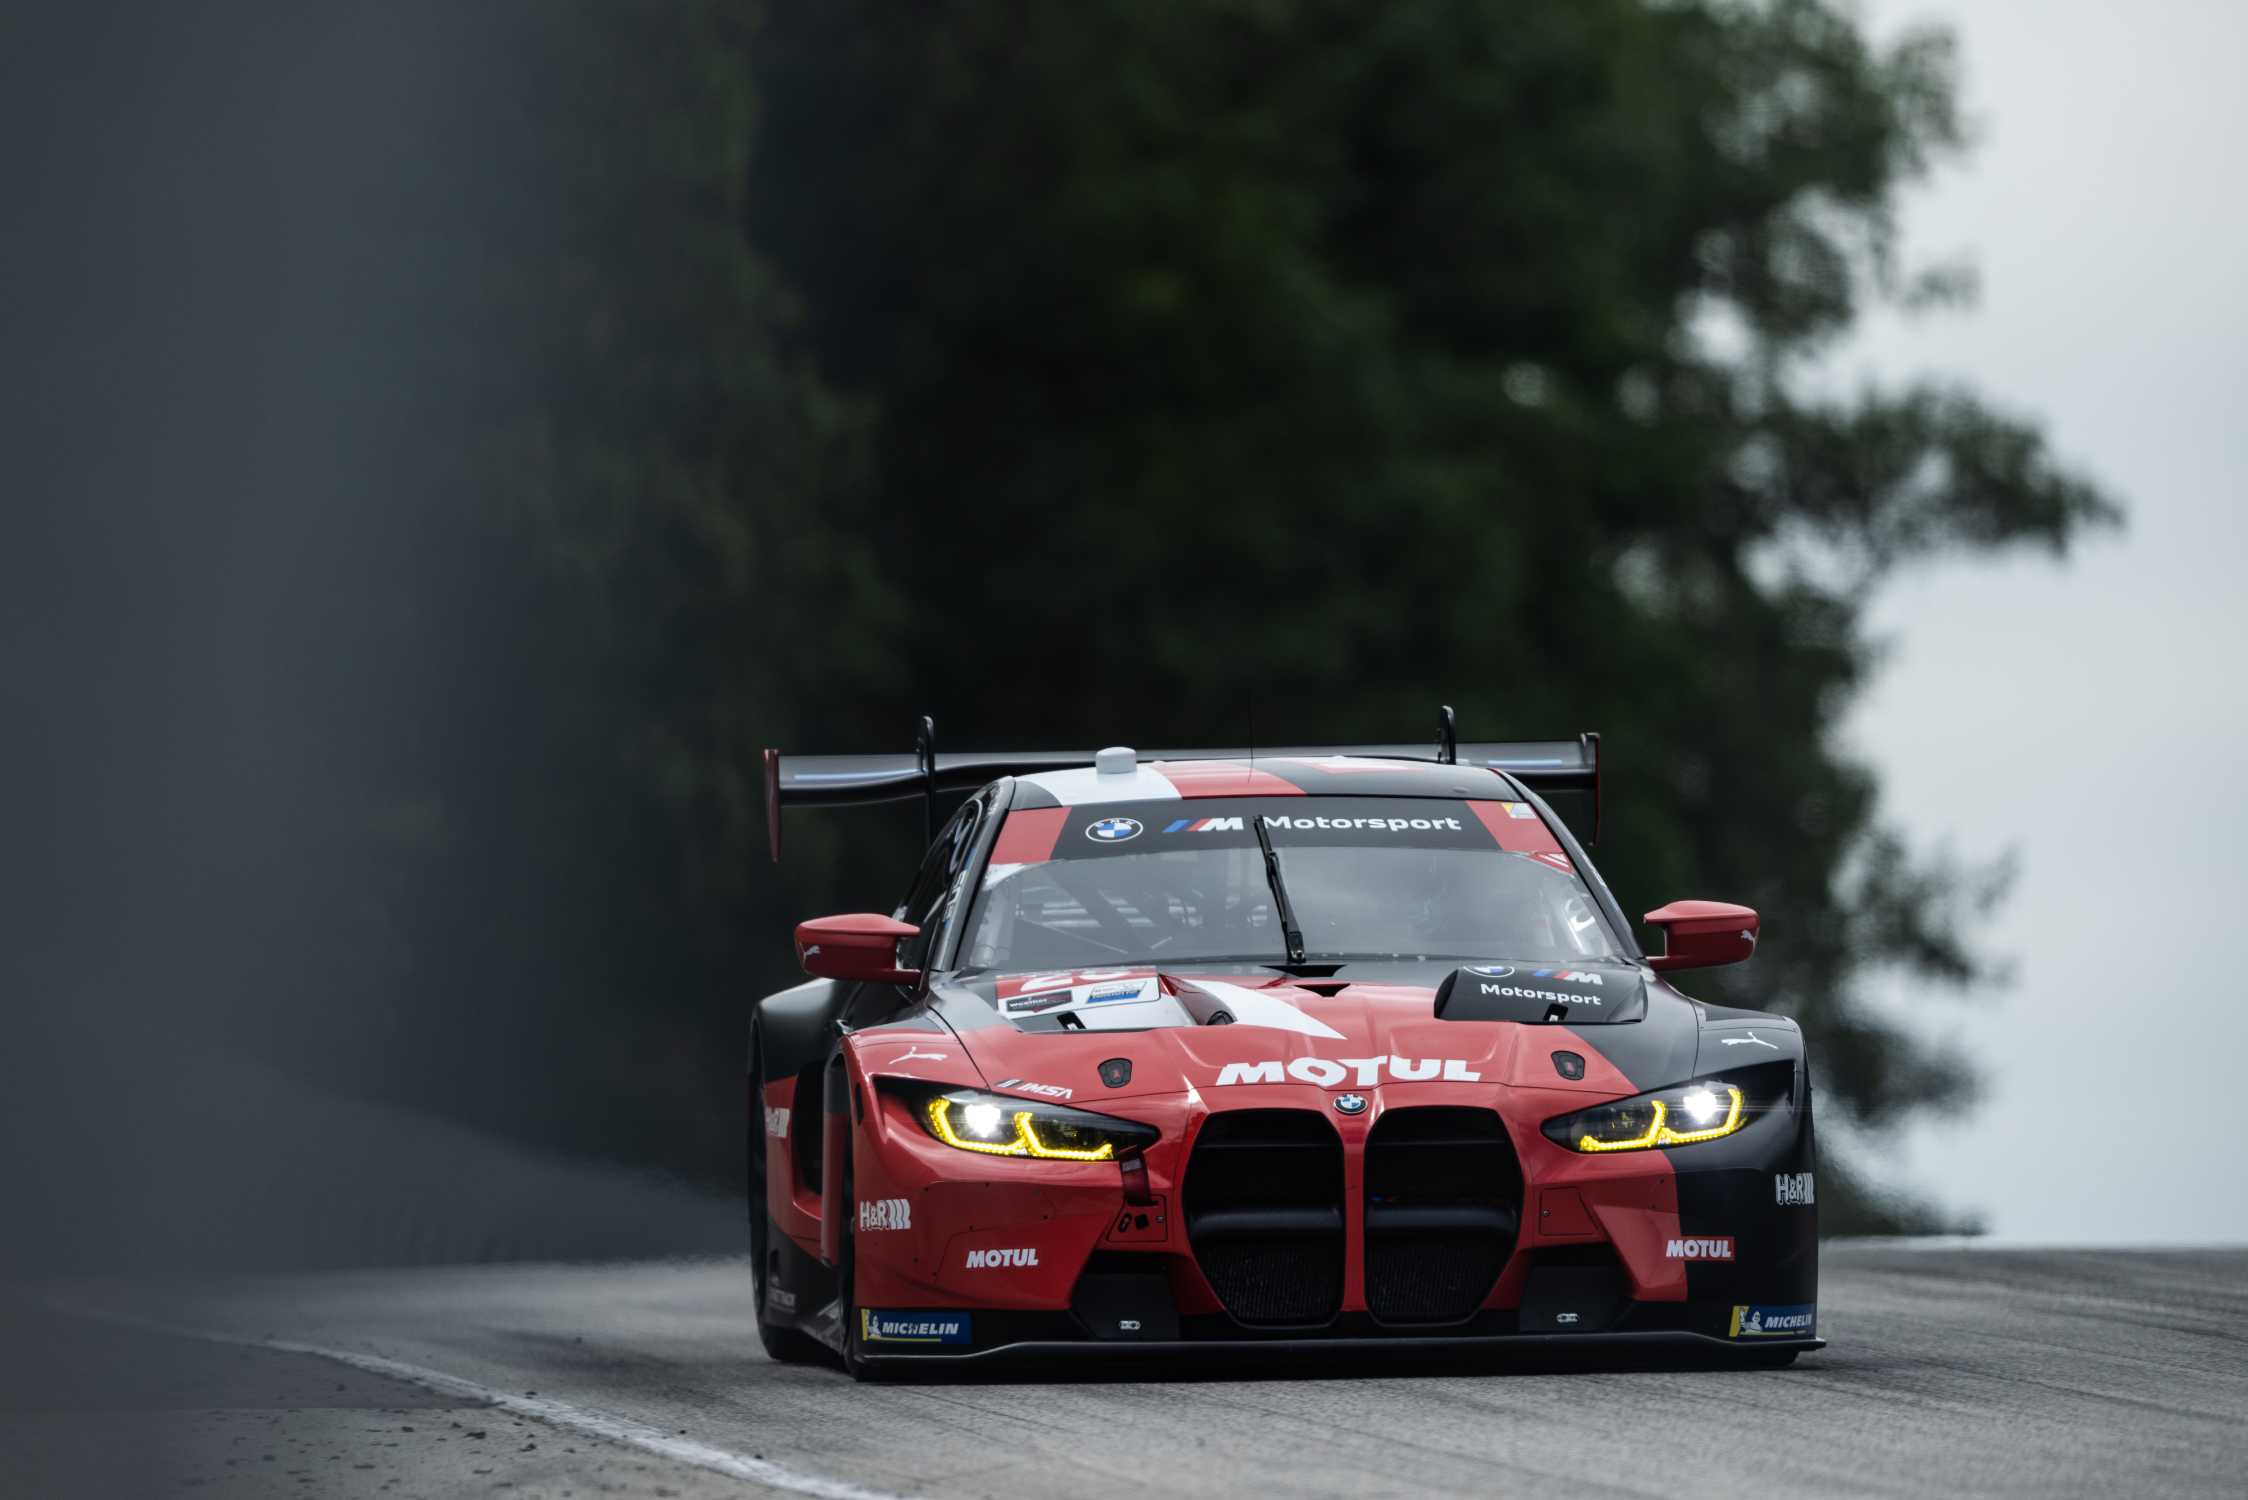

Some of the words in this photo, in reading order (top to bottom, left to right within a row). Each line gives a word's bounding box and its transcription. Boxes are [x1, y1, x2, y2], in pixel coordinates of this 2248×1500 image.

[1263, 815, 1463, 831] Motorsport
[1480, 983, 1602, 1005] Motorsport
[1215, 1055, 1482, 1087] MOTUL
[1017, 1082, 1073, 1099] IMSA
[1775, 1173, 1805, 1205] H&R
[860, 1199, 890, 1231] H&R
[1666, 1239, 1732, 1257] MOTUL
[966, 1248, 1039, 1268] MOTUL
[882, 1322, 960, 1335] MICHELIN
[1765, 1313, 1813, 1329] MICHELIN
